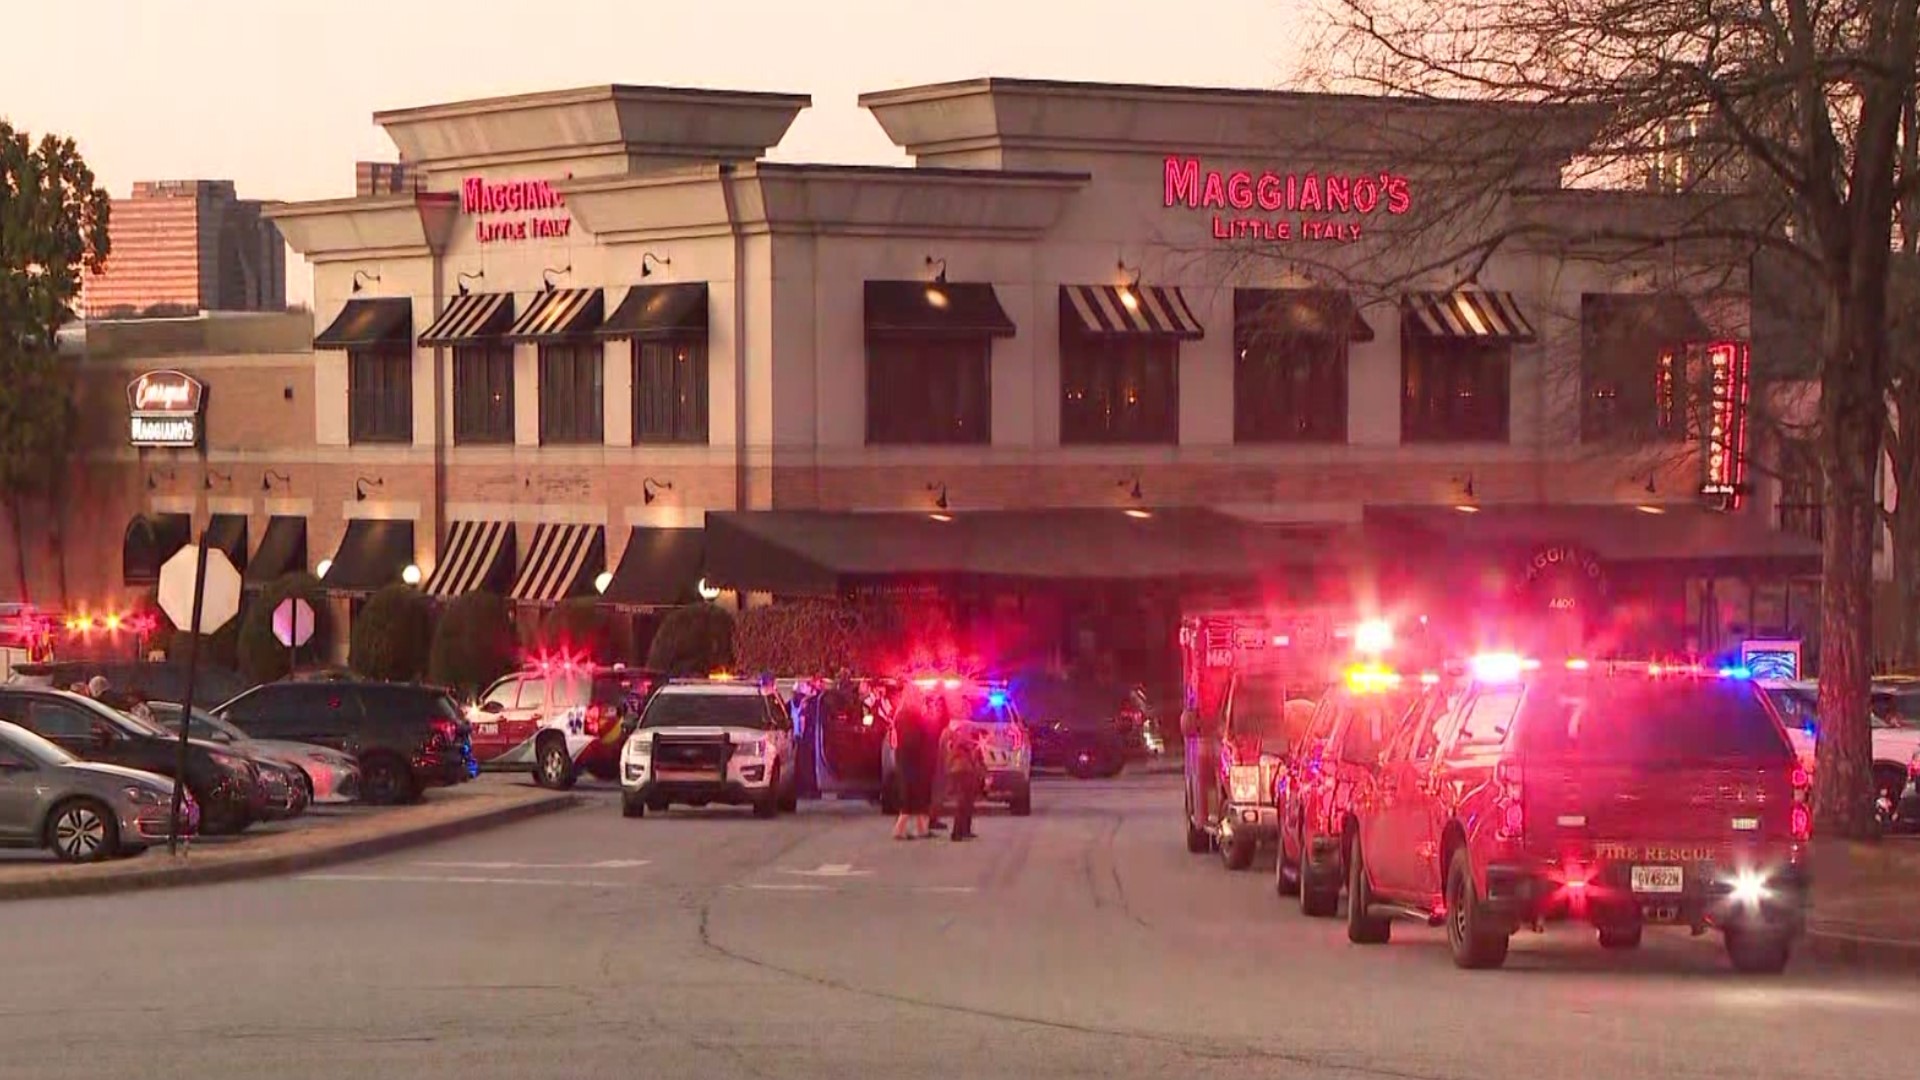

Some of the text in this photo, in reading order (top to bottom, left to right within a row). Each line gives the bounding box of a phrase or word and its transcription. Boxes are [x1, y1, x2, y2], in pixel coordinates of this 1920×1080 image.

[1164, 156, 1411, 214] MAGGIANO'S
[477, 218, 570, 242] LITTLE ITALY
[1213, 214, 1361, 241] LITTLE ITALY
[1596, 843, 1715, 861] FIRE RESCUE
